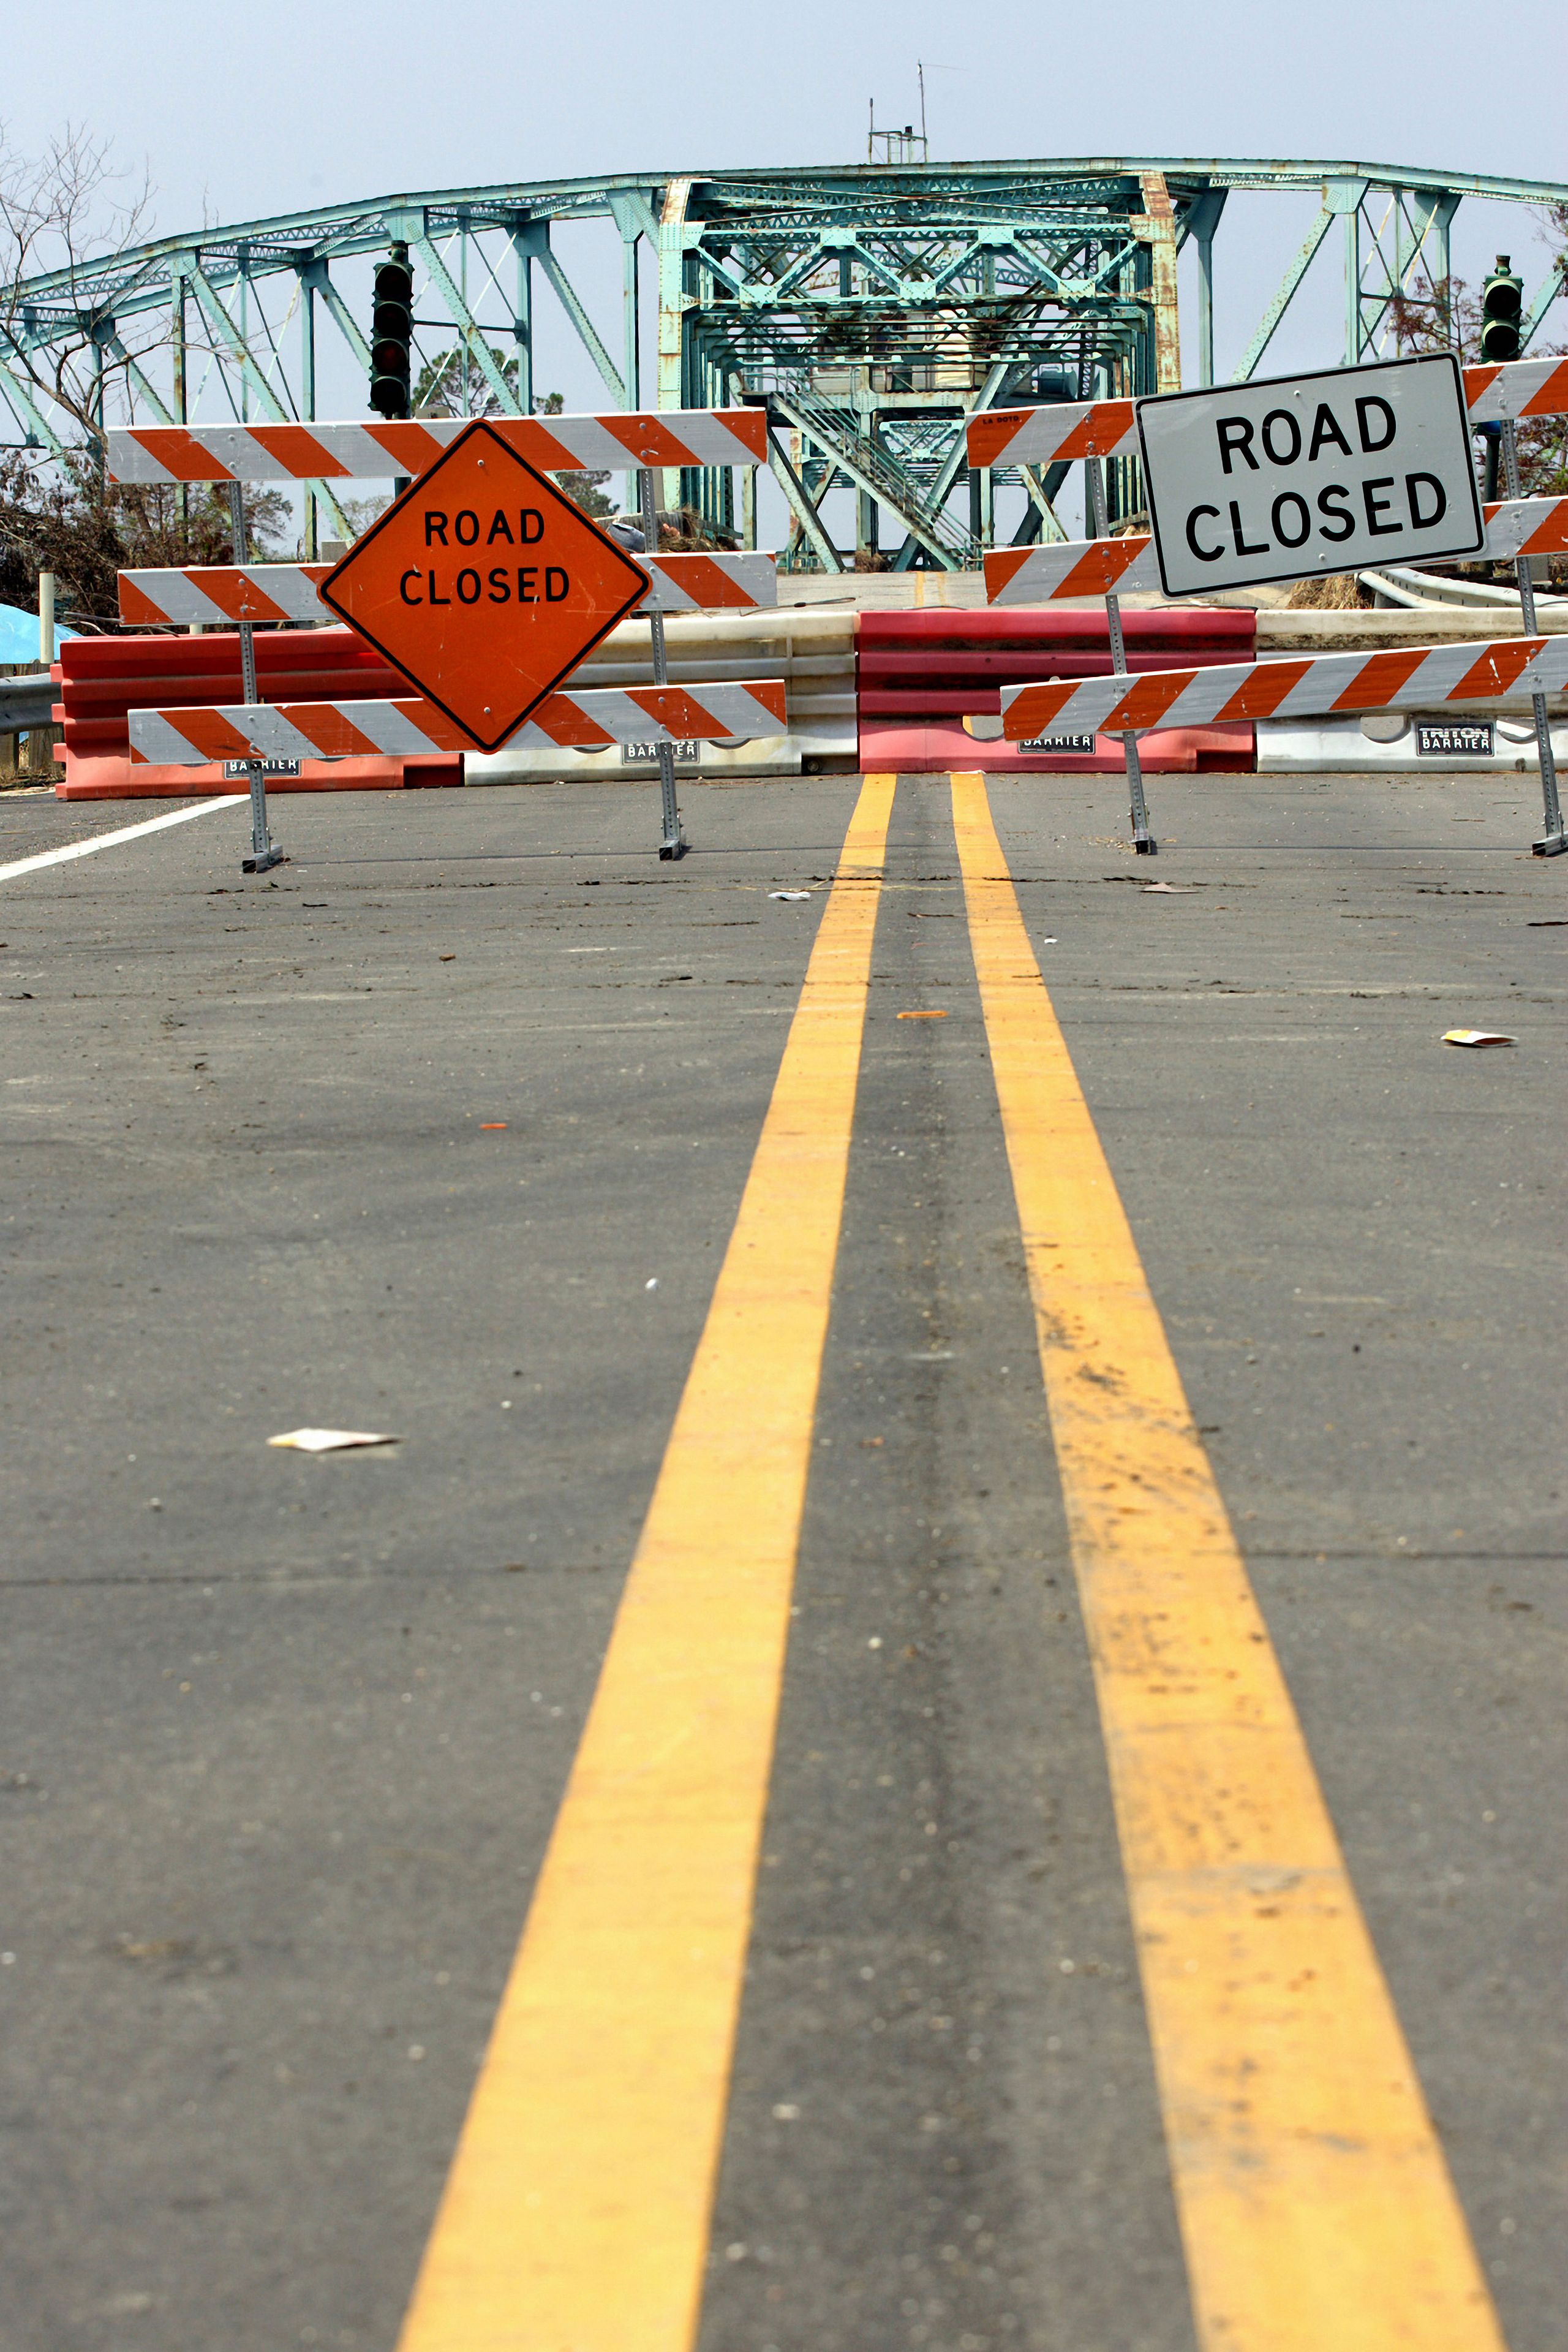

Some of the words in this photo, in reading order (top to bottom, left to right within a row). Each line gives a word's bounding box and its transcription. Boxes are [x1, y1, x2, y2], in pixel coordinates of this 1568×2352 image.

[1216, 395, 1396, 474] ROAD
[424, 509, 545, 546] ROAD
[1186, 472, 1447, 562] CLOSED
[399, 567, 570, 605] CLOSED
[1419, 727, 1489, 738] TRITON
[1422, 738, 1489, 749] BARRIER
[628, 745, 695, 757] BARER
[230, 760, 296, 772] BARIER
